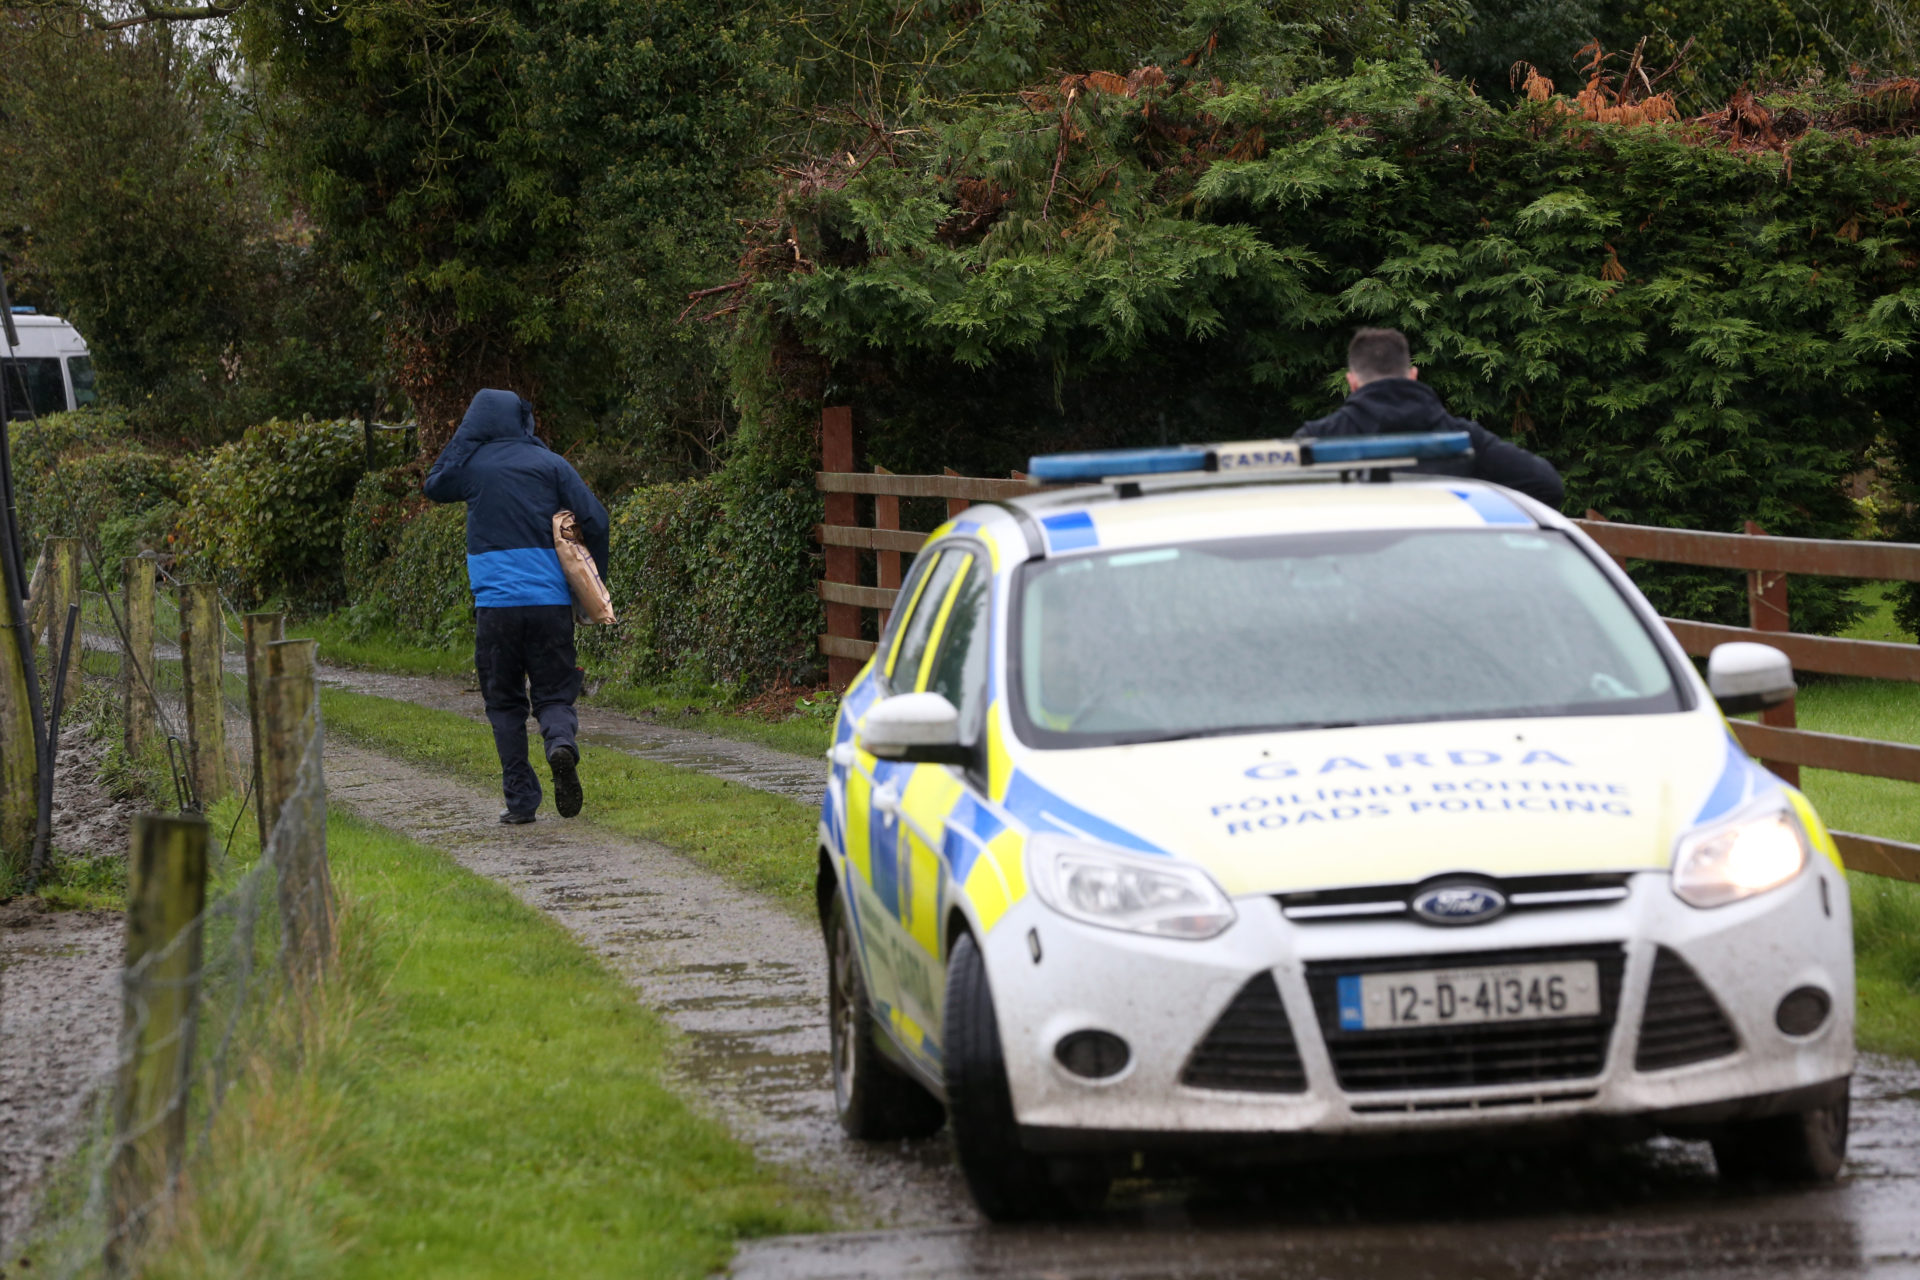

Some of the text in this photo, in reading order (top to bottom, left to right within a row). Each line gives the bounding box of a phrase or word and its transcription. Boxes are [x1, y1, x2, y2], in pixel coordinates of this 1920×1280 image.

[1243, 749, 1575, 781] GARDA
[1226, 797, 1633, 837] ROADS POLICING
[1433, 890, 1484, 915] Ford
[1388, 975, 1567, 1022] 12-D-41346
